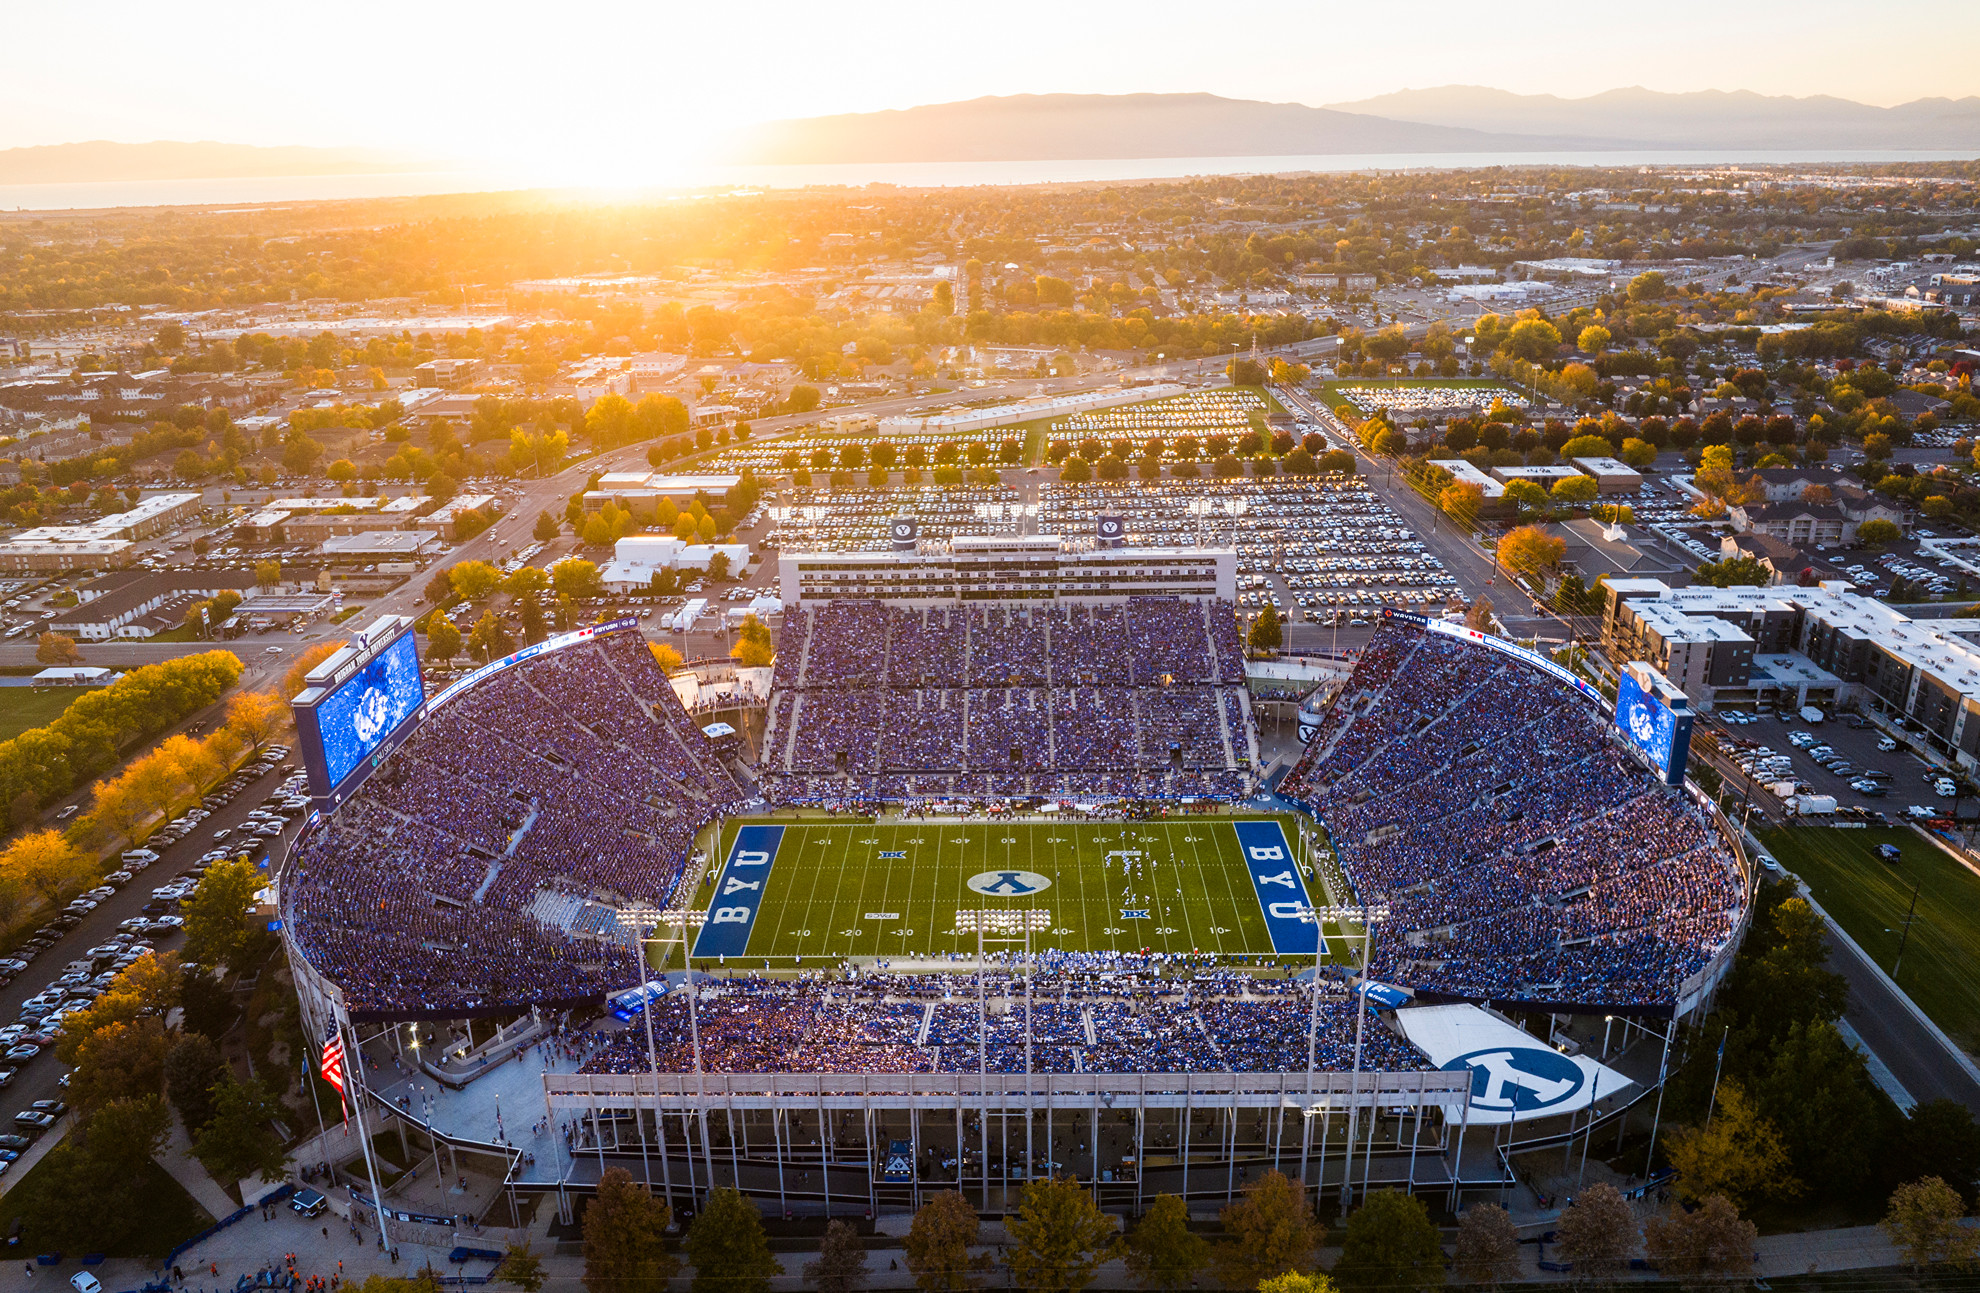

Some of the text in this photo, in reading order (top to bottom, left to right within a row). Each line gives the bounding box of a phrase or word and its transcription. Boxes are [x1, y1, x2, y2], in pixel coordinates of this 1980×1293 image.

[899, 526, 908, 534] Y
[1106, 523, 1115, 531] Y
[1392, 611, 1426, 624] WAYSTAR
[594, 622, 618, 634] #BYUSN
[356, 648, 371, 666] YOUNG
[370, 628, 395, 654] UNIVERSITY
[360, 633, 368, 649] Y
[1301, 727, 1317, 740] Y
[712, 850, 769, 924] BYU
[981, 872, 1037, 893] Y
[1249, 845, 1304, 919] BYU
[1155, 927, 1173, 935] 20
[1465, 1051, 1575, 1107] Y
